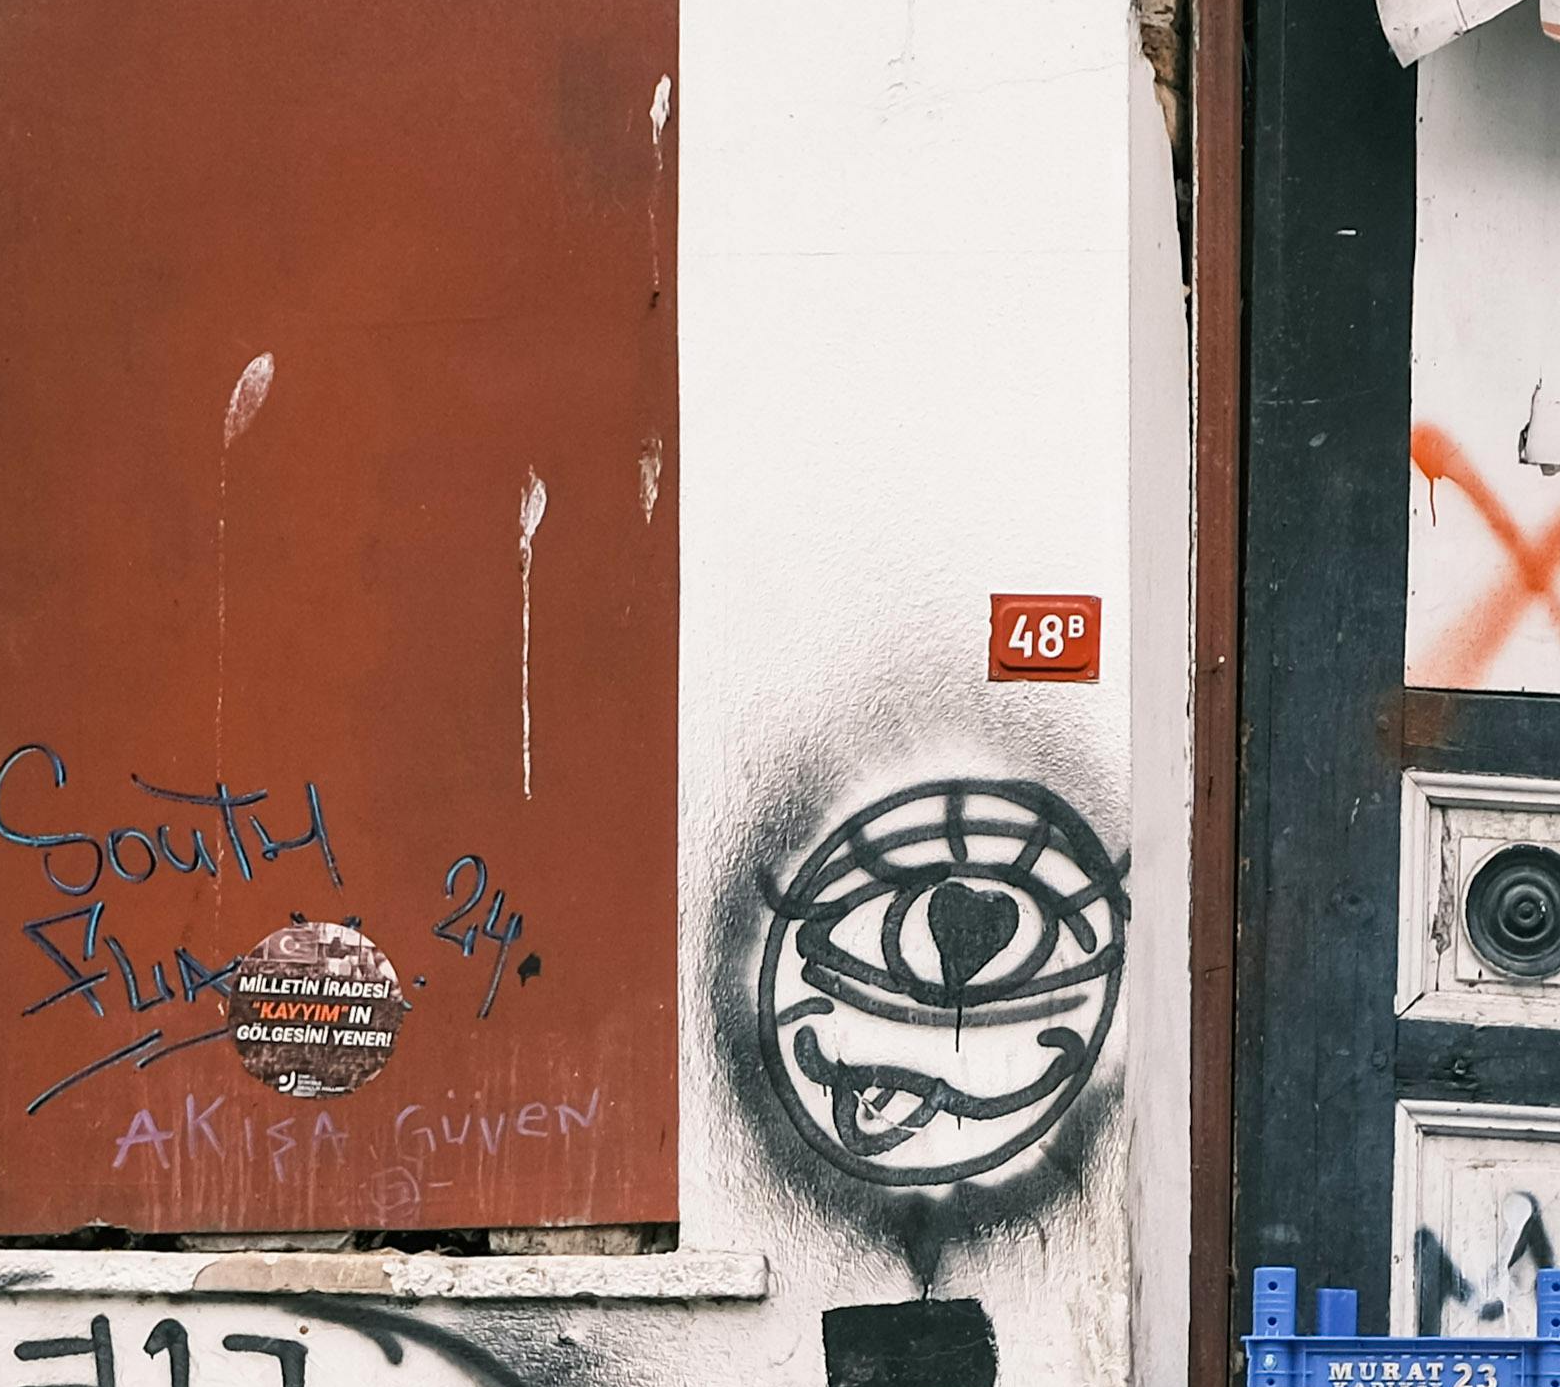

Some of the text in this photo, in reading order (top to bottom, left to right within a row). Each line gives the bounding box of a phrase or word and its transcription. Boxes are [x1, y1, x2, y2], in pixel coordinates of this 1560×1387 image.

[239, 974, 391, 999] MİLLETİN İRADESİ
[236, 1022, 392, 1048] GÖLGESİNİ YENER!
[1328, 1362, 1444, 1381] MURAT
